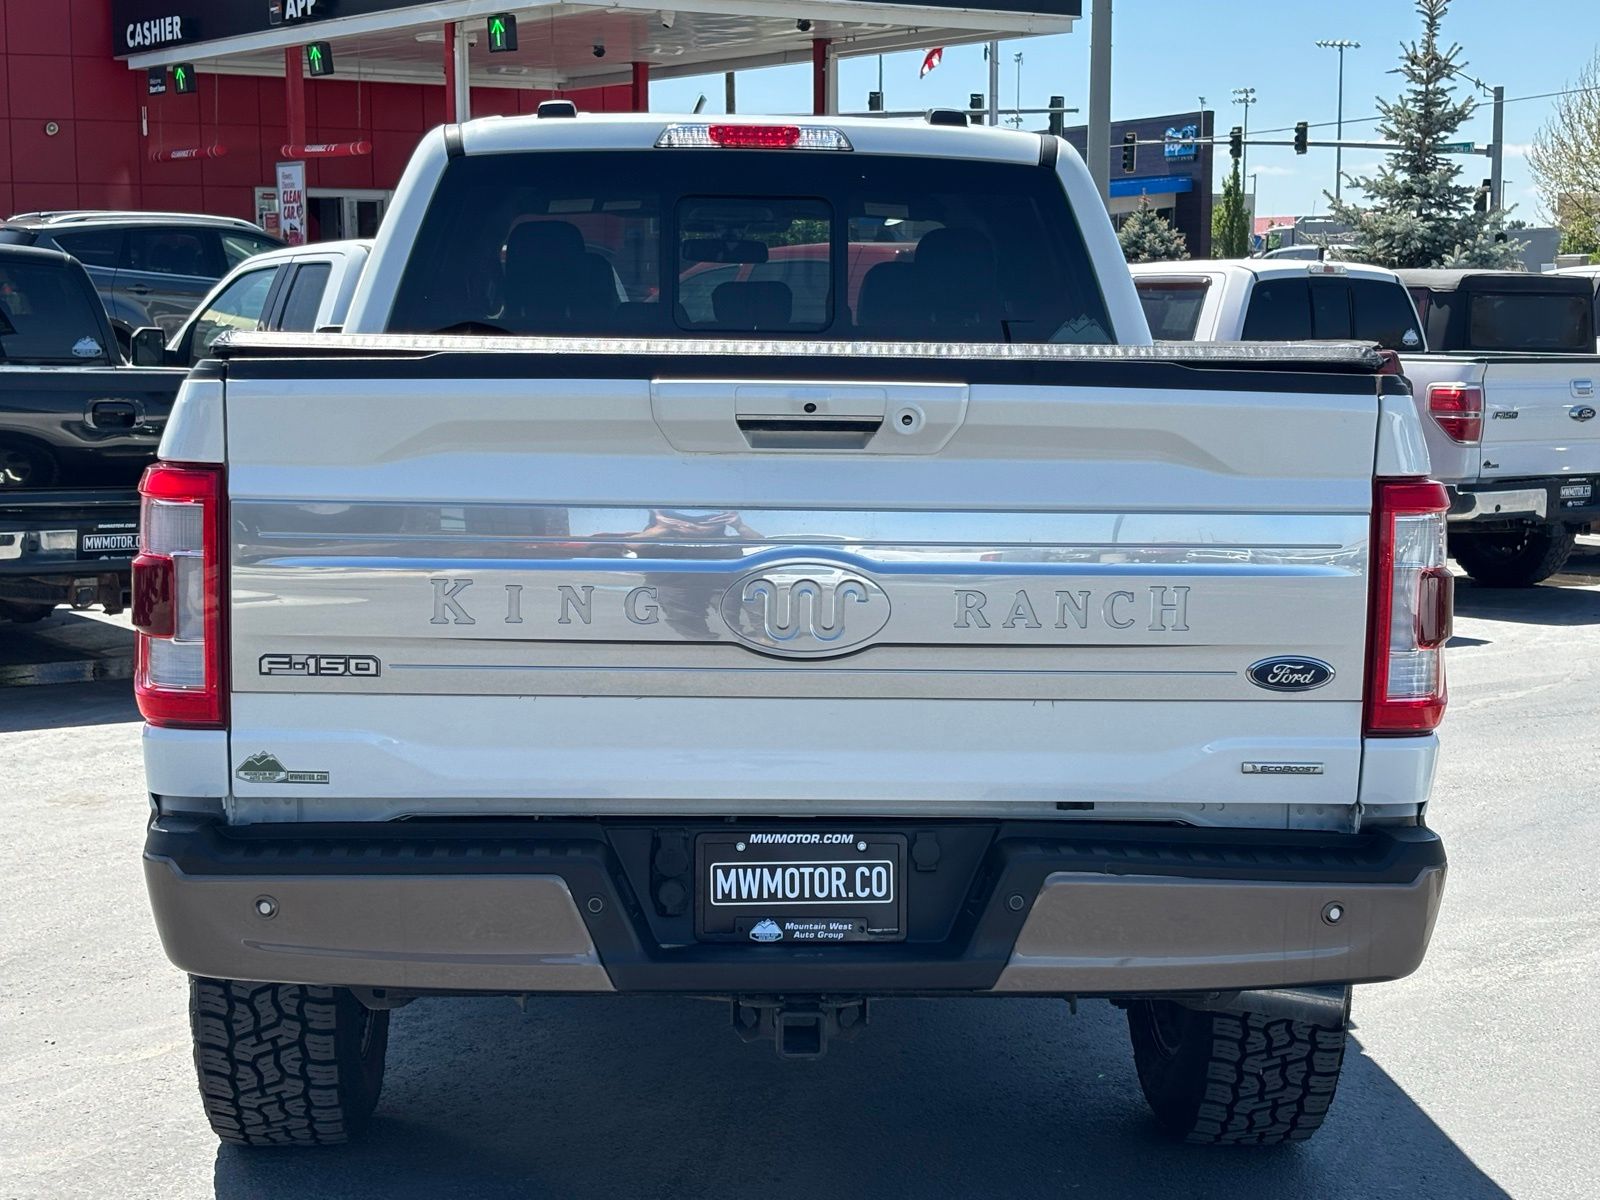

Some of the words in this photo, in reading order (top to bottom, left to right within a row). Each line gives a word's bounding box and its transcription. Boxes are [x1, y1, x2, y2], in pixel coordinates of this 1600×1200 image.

[126, 15, 182, 48] CASHIER
[282, 189, 302, 204] CLEAN
[85, 535, 141, 550] MWMOTOR.C
[429, 578, 660, 625] KING
[953, 586, 1191, 632] RANCH
[259, 653, 381, 677] F-150
[1267, 663, 1316, 684] Ford
[749, 833, 854, 844] MWMOTOR.COM
[716, 866, 887, 900] MWMOTOR.CO
[785, 922, 827, 931] Mountain
[829, 922, 853, 931] West
[793, 931, 815, 939] Auto
[817, 931, 844, 940] Group
